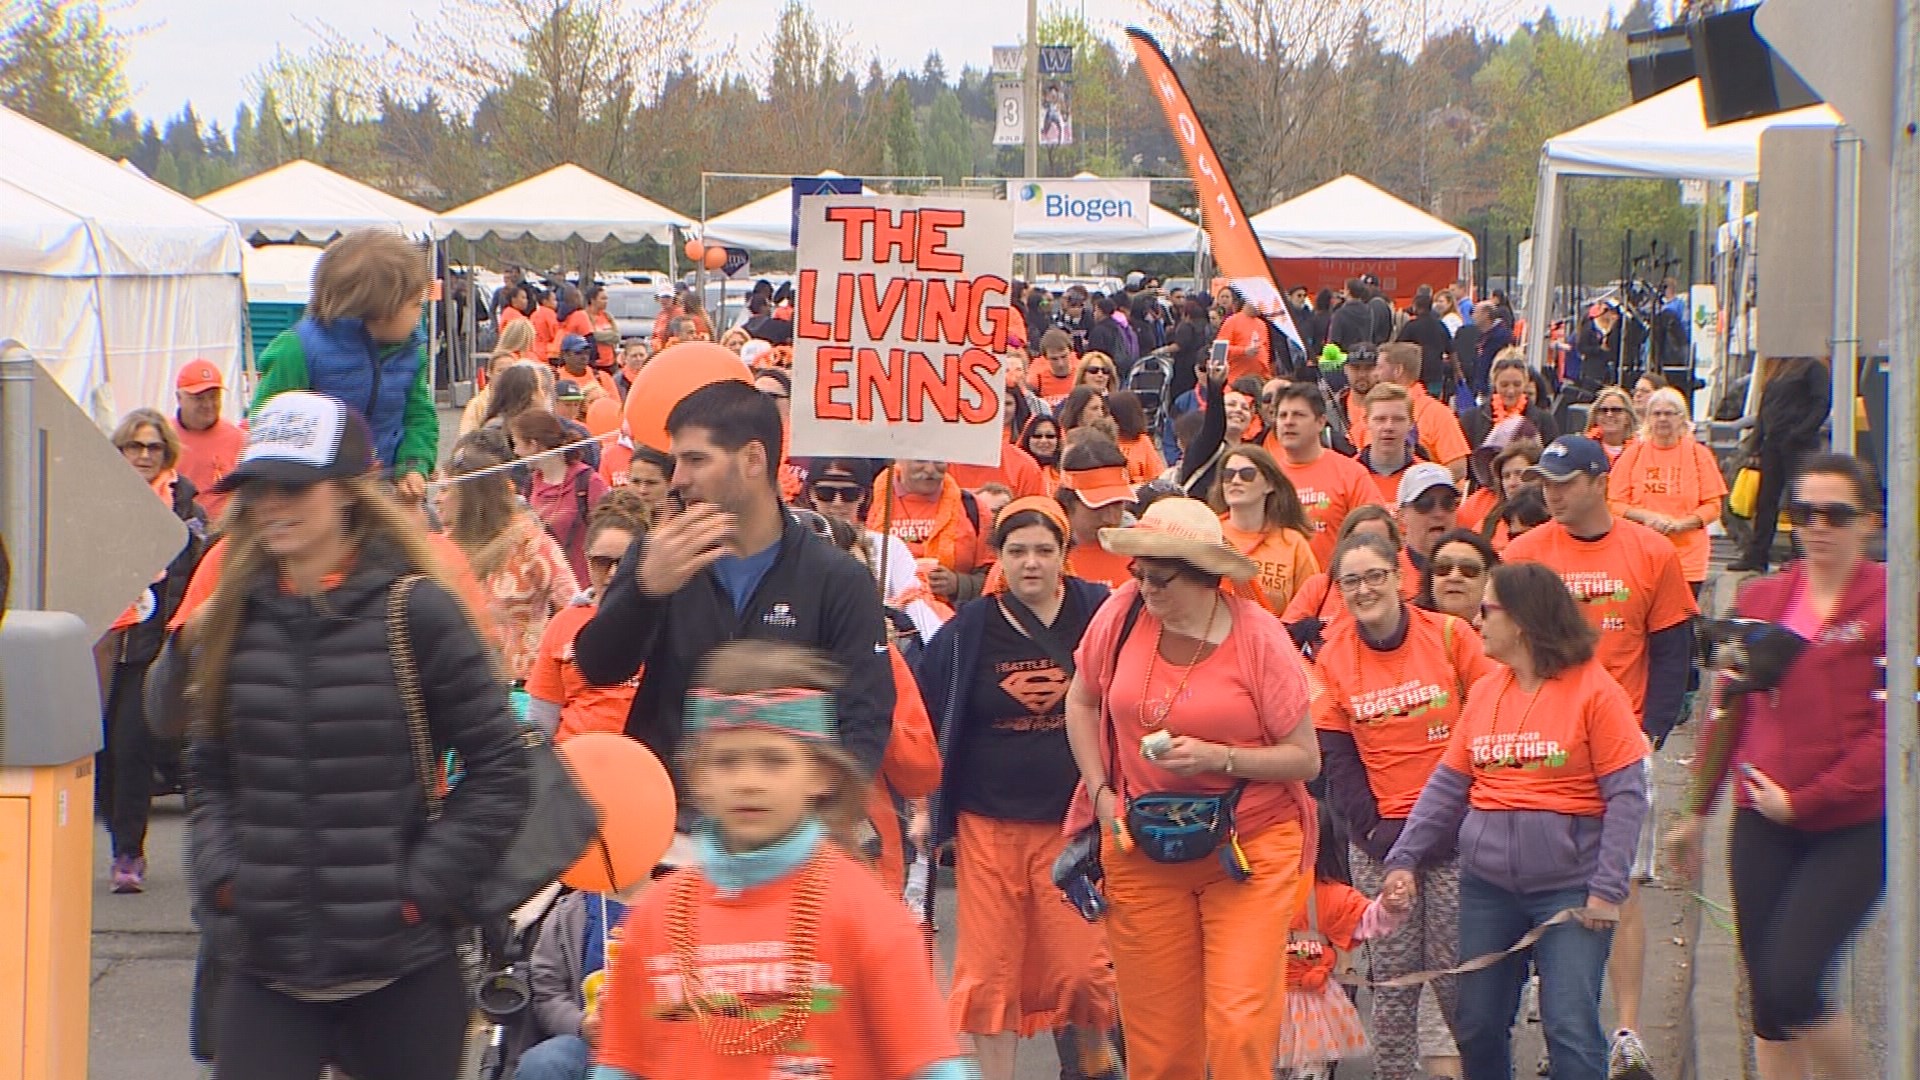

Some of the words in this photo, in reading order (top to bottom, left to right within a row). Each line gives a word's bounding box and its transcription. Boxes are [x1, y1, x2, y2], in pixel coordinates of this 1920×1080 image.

[1041, 47, 1071, 71] W
[1002, 96, 1020, 128] 3
[1046, 193, 1133, 222] Biogen
[825, 206, 965, 273] THE
[799, 269, 1011, 354] LIVING
[814, 345, 1004, 424] ENNS
[1352, 685, 1448, 717] TOGETHER.
[1472, 740, 1566, 762] TOGETHER.
